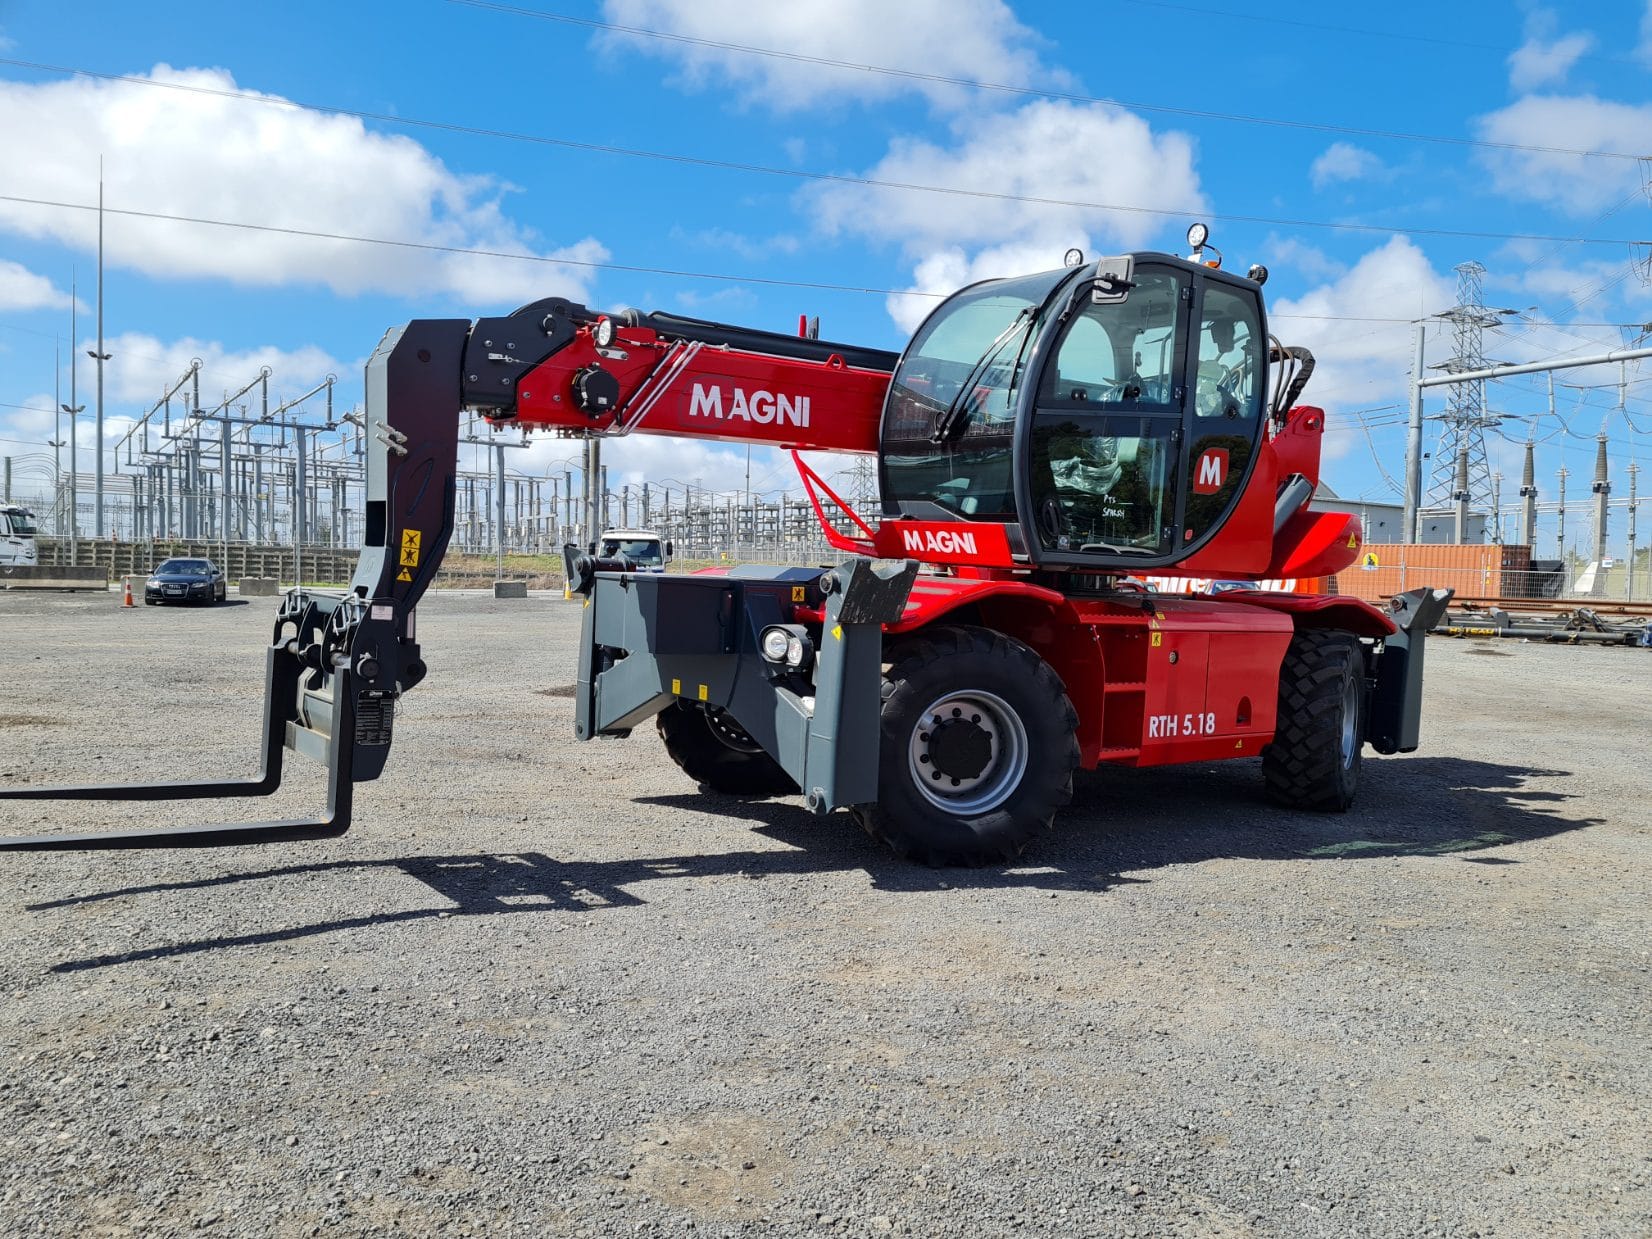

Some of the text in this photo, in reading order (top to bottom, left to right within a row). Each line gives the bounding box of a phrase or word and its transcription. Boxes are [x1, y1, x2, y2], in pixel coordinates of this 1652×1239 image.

[689, 382, 811, 428] MAGNI
[1199, 455, 1220, 486] M
[903, 529, 978, 555] MAGNI
[1149, 712, 1216, 738] RTH 5.18
